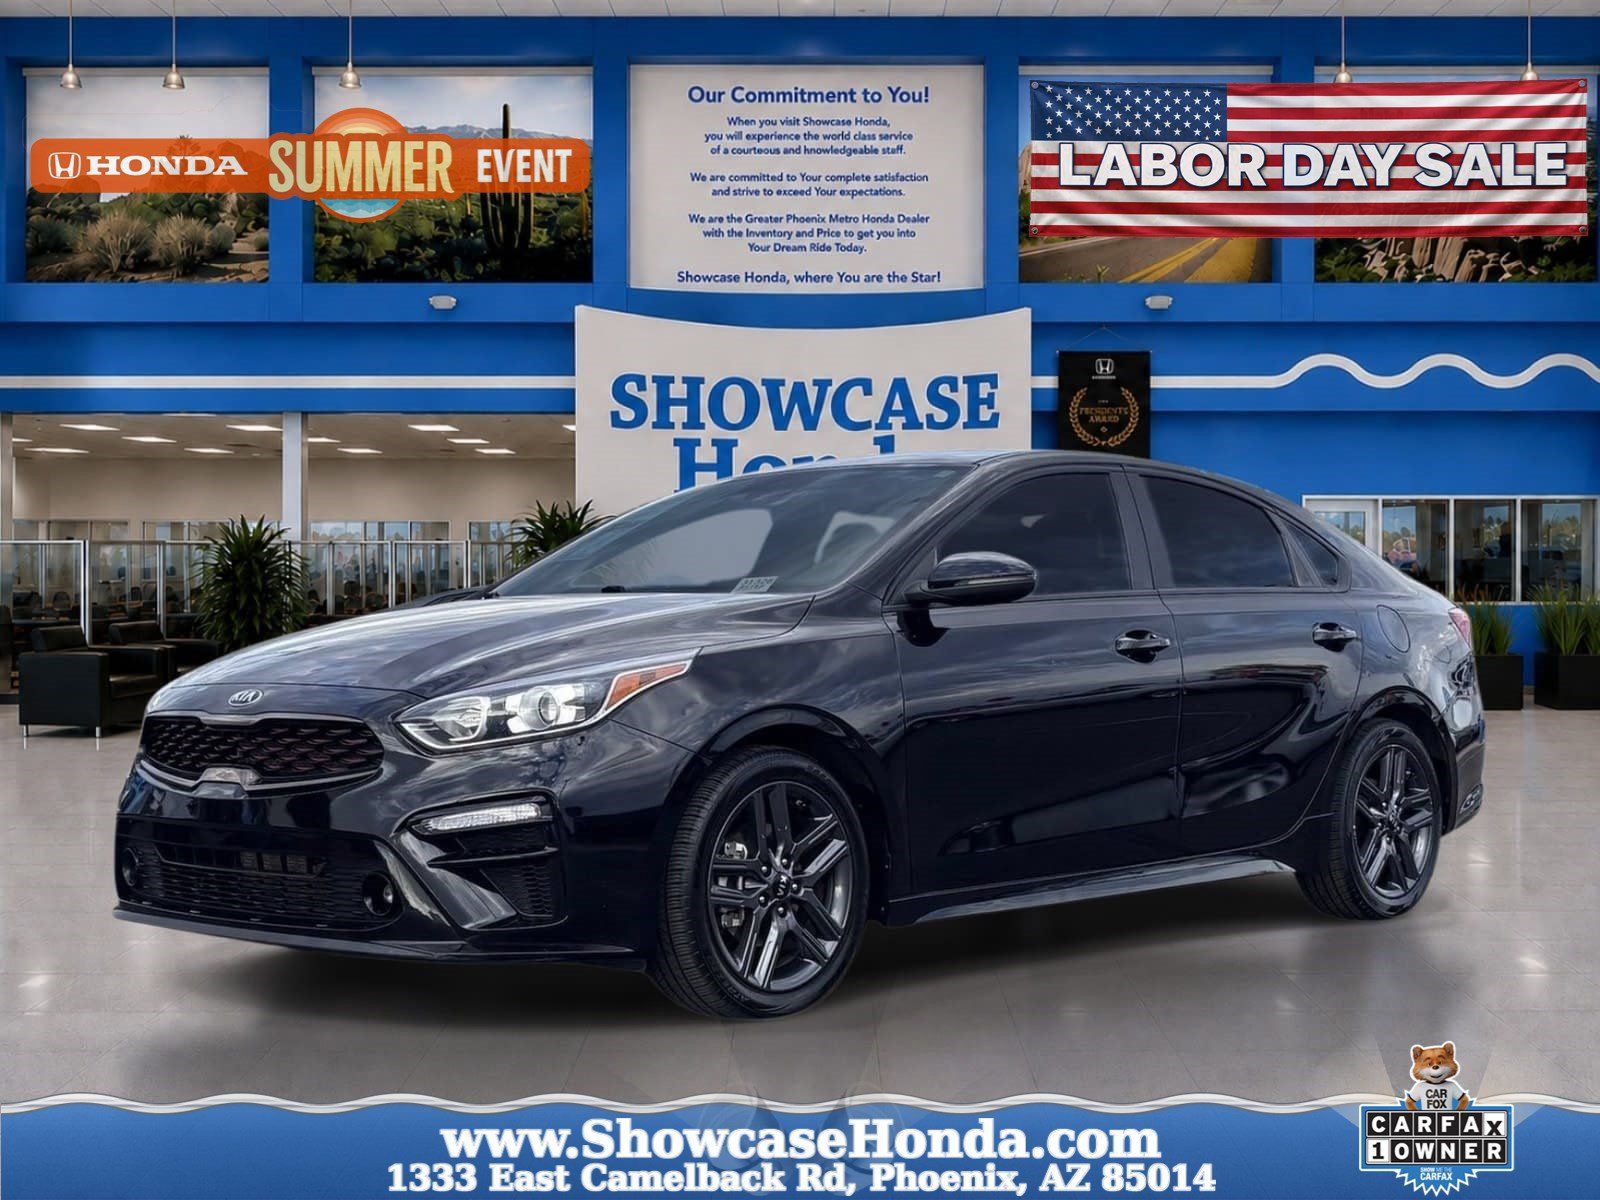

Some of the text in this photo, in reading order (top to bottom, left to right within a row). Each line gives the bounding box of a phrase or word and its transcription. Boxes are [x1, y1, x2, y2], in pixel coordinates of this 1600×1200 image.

[688, 86, 929, 103] Our Commitment to You!
[727, 116, 890, 128] When you visit Showcase Honda,
[705, 131, 913, 142] you will experience the world class service
[710, 145, 720, 154] of
[731, 147, 781, 155] courteous
[783, 145, 801, 154] and
[882, 144, 905, 154] staff.
[690, 172, 707, 182] We
[728, 172, 783, 182] committed
[786, 174, 797, 182] to
[800, 172, 822, 182] Your
[825, 172, 871, 184] complete
[874, 172, 928, 182] satisfaction
[712, 186, 905, 198] and strive to exceed Your expectations.
[688, 213, 930, 224] We are the Greater Phoenix Metro Honda Dealer
[703, 228, 724, 237] with
[727, 228, 743, 238] the
[746, 228, 793, 240] Inventory
[795, 228, 814, 238] and
[817, 228, 841, 238] Price
[857, 230, 874, 240] get
[876, 231, 894, 240] you
[897, 228, 916, 237] into
[748, 243, 867, 254] Your Dream Ride Today.
[677, 271, 940, 285] Showcase Honda, where You are the Star!
[609, 373, 1000, 432] SHOWCASE
[229, 689, 262, 705] KIA
